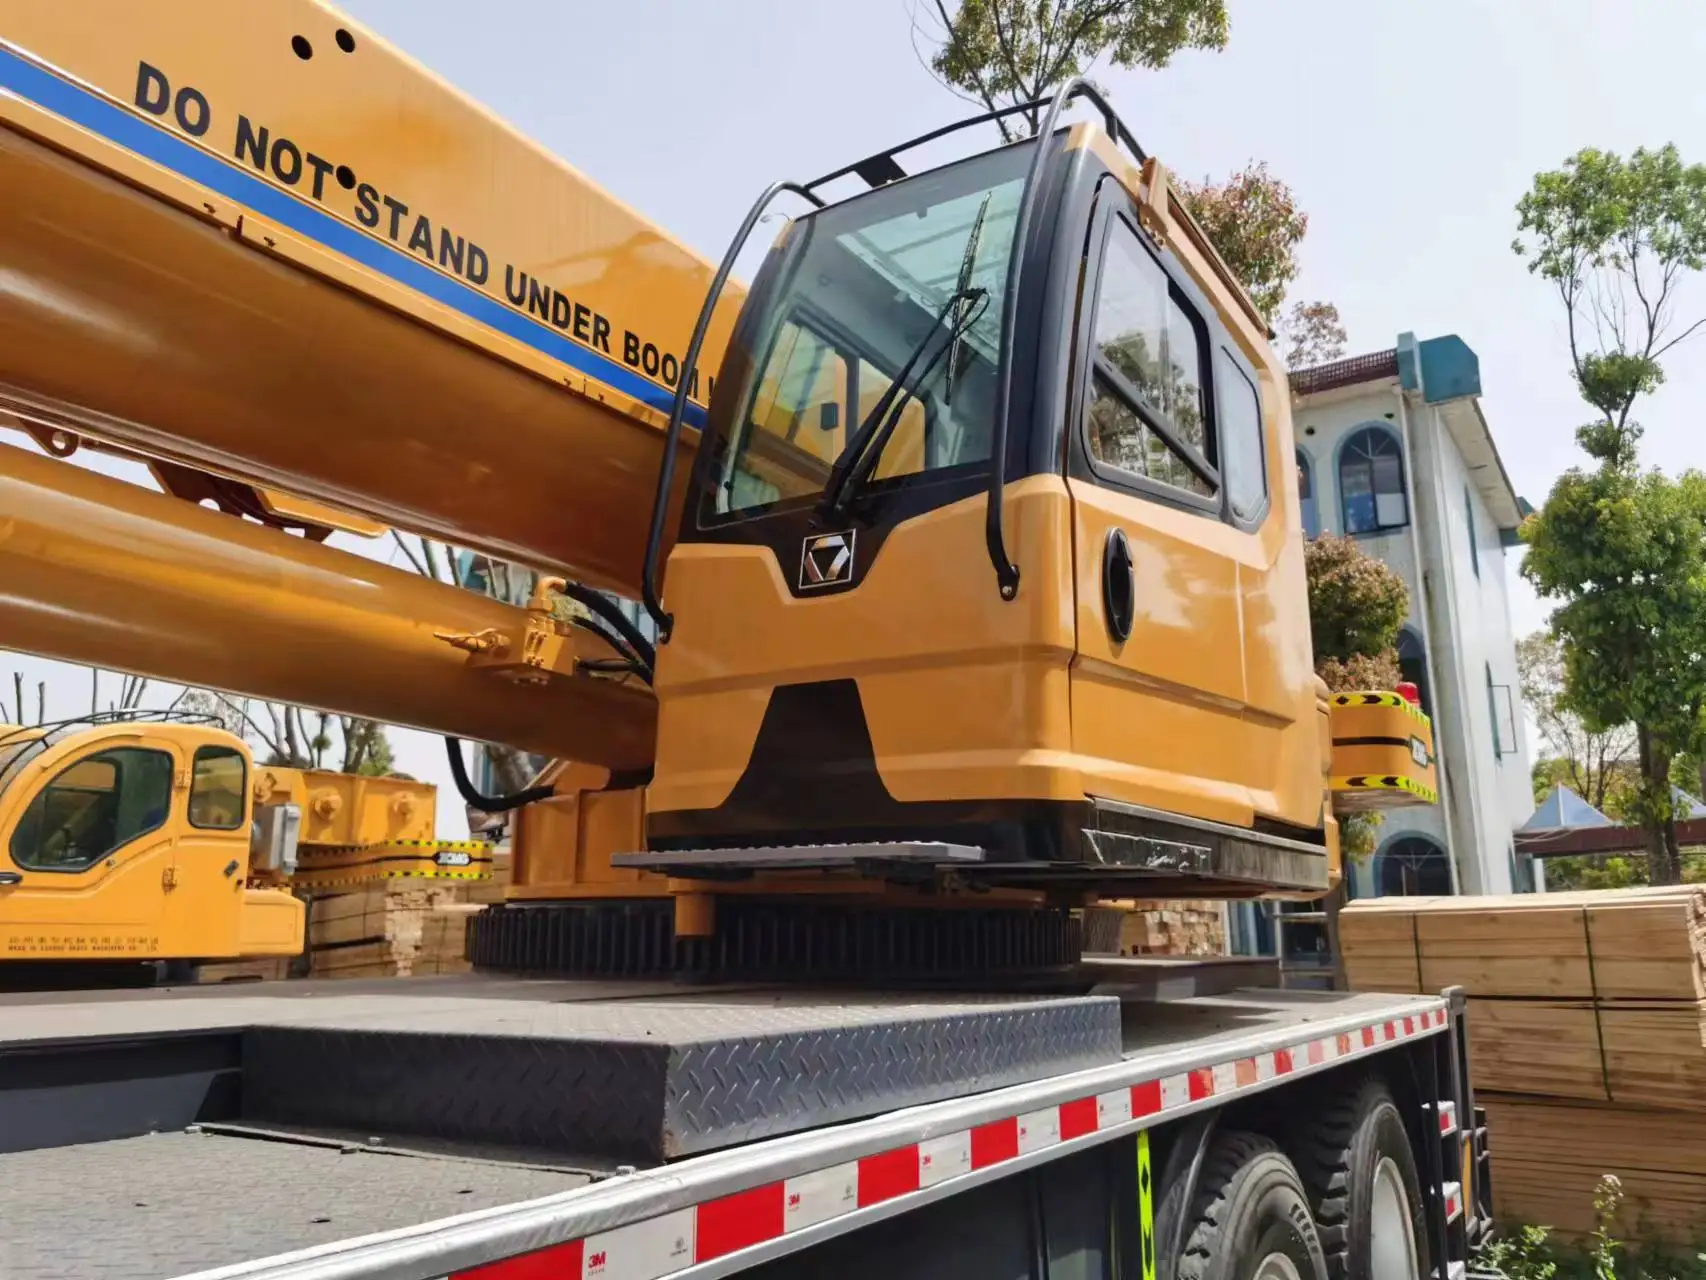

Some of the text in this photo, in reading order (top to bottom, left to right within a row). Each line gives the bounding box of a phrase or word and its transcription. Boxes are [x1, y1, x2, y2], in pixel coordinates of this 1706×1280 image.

[135, 60, 211, 137] DO
[235, 114, 334, 201] NOT
[354, 181, 489, 286] STAND
[505, 264, 611, 354] UNDER
[588, 1250, 606, 1268] 3M
